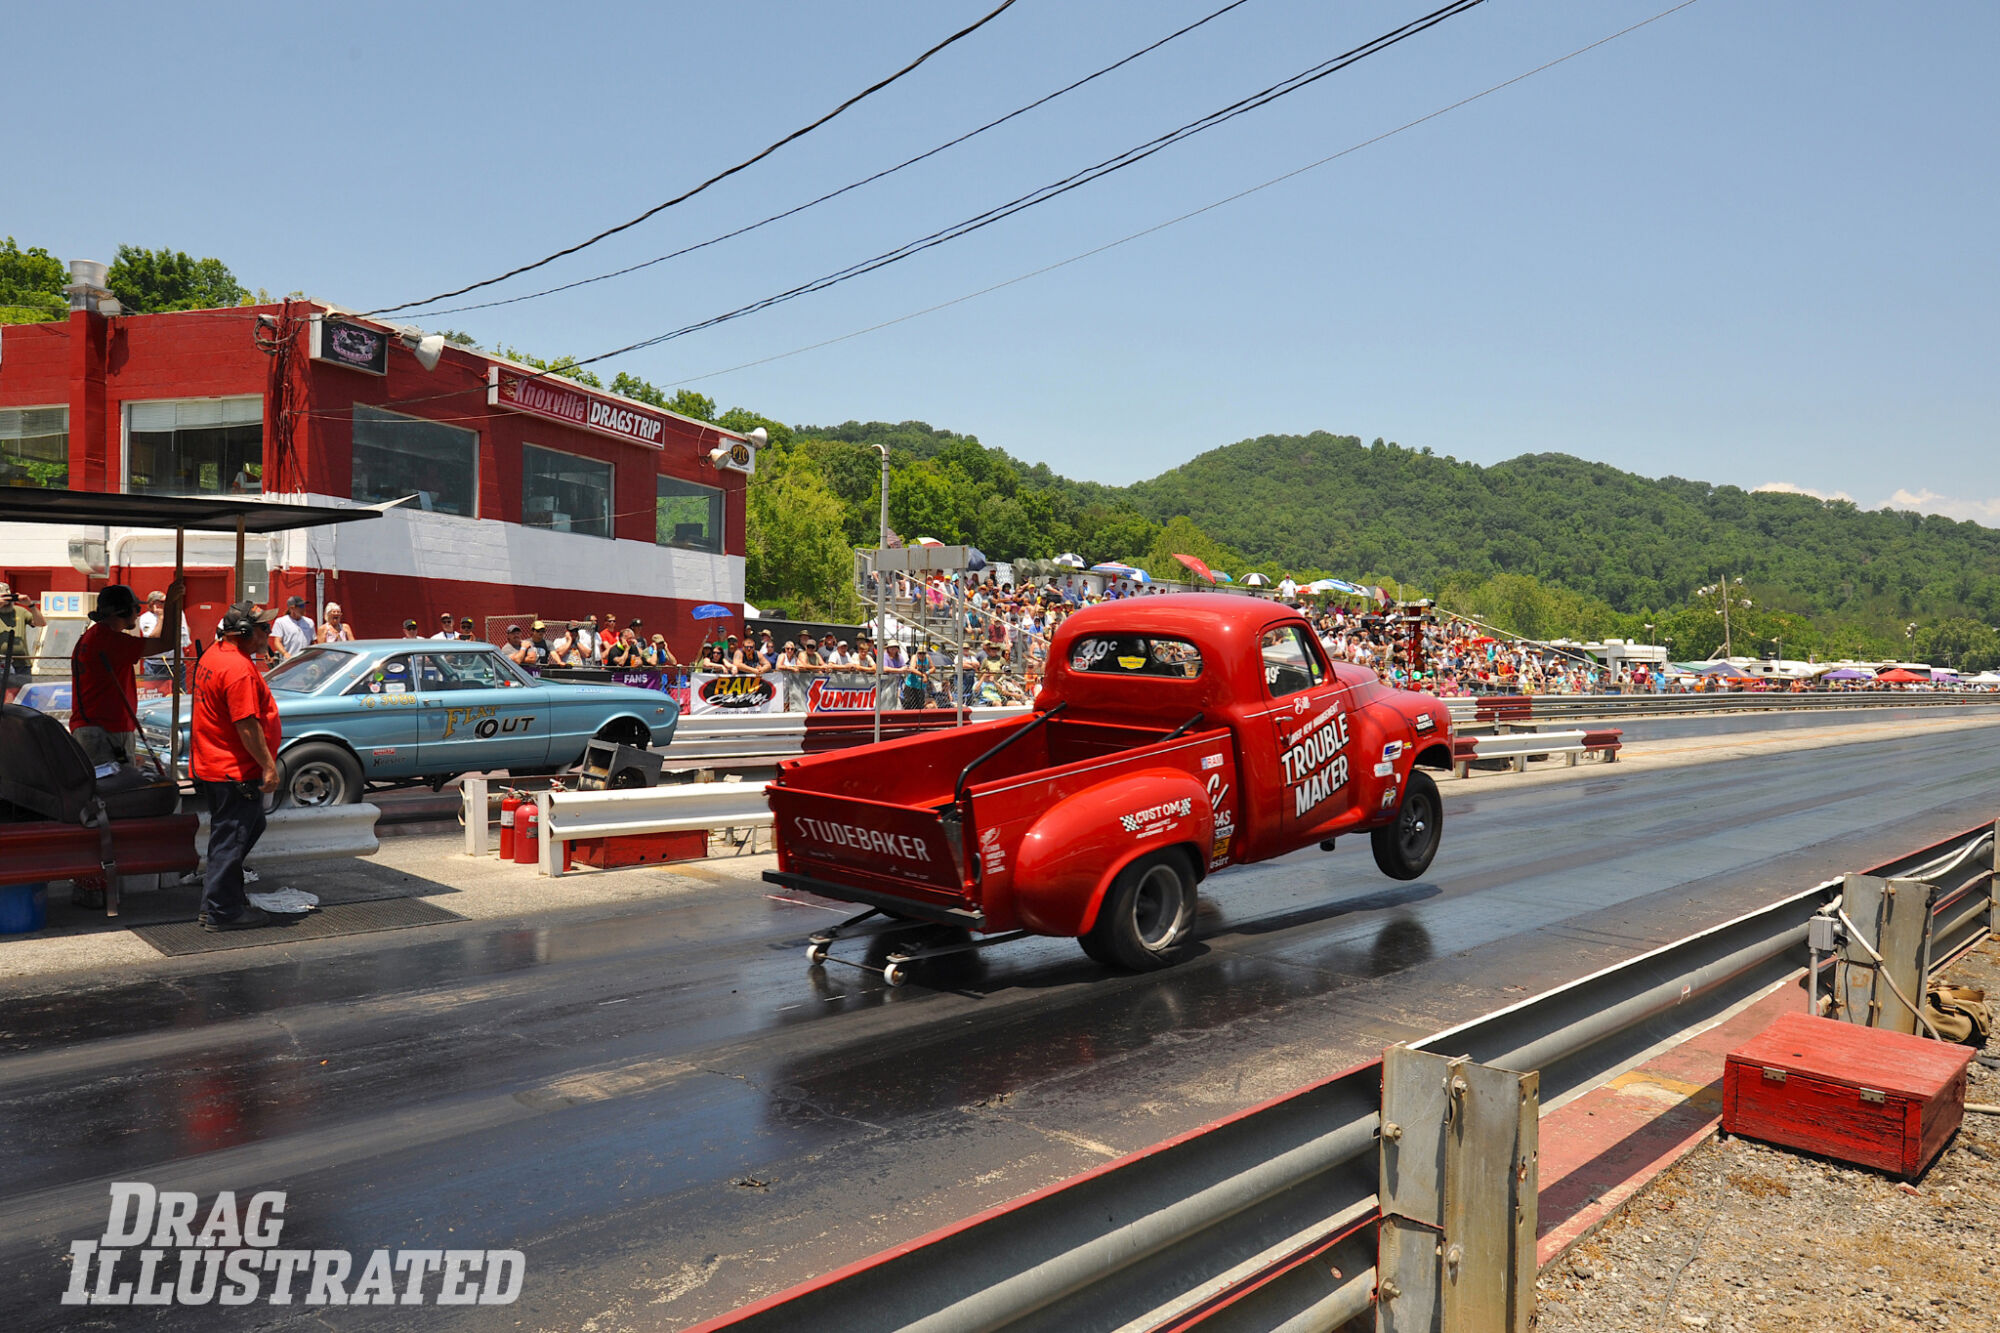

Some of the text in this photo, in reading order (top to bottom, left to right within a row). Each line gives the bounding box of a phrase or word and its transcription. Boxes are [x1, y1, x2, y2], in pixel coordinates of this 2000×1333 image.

[514, 379, 661, 440] Knoxville DRAGSTRIP
[733, 446, 748, 461] PTC
[45, 596, 80, 611] ICE
[624, 674, 648, 684] FANS
[714, 677, 761, 694] RAM
[442, 705, 500, 739] FLAT
[473, 716, 536, 739] OUT
[1281, 712, 1349, 785] TROUBLE
[1295, 754, 1348, 818] MAKER
[1136, 801, 1180, 823] CUSTOM
[794, 816, 931, 862] STUDEBAKER
